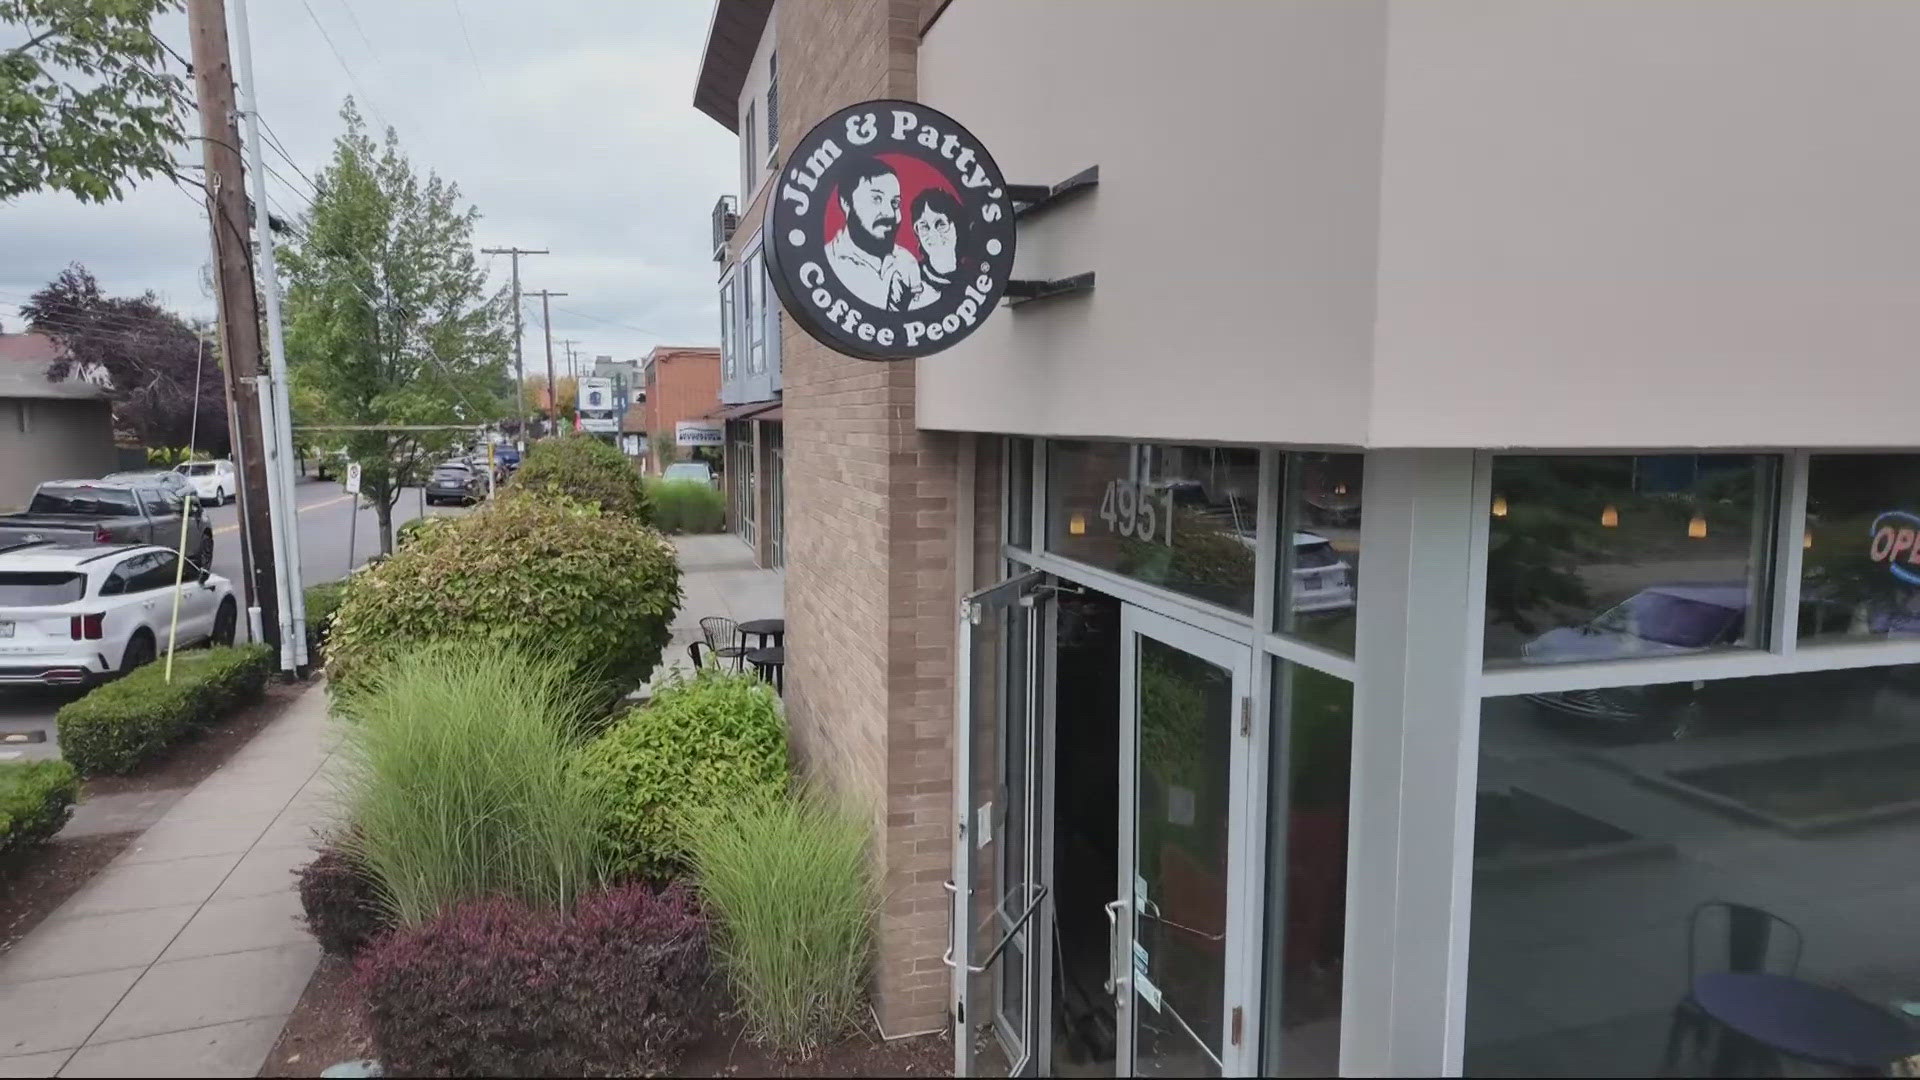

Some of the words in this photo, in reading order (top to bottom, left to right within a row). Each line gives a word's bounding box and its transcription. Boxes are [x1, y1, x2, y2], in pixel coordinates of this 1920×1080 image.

[783, 139, 843, 216] Jim
[845, 113, 878, 145] &
[891, 110, 1002, 222] Patty's
[799, 261, 895, 346] Coffee
[1100, 480, 1173, 547] 4951
